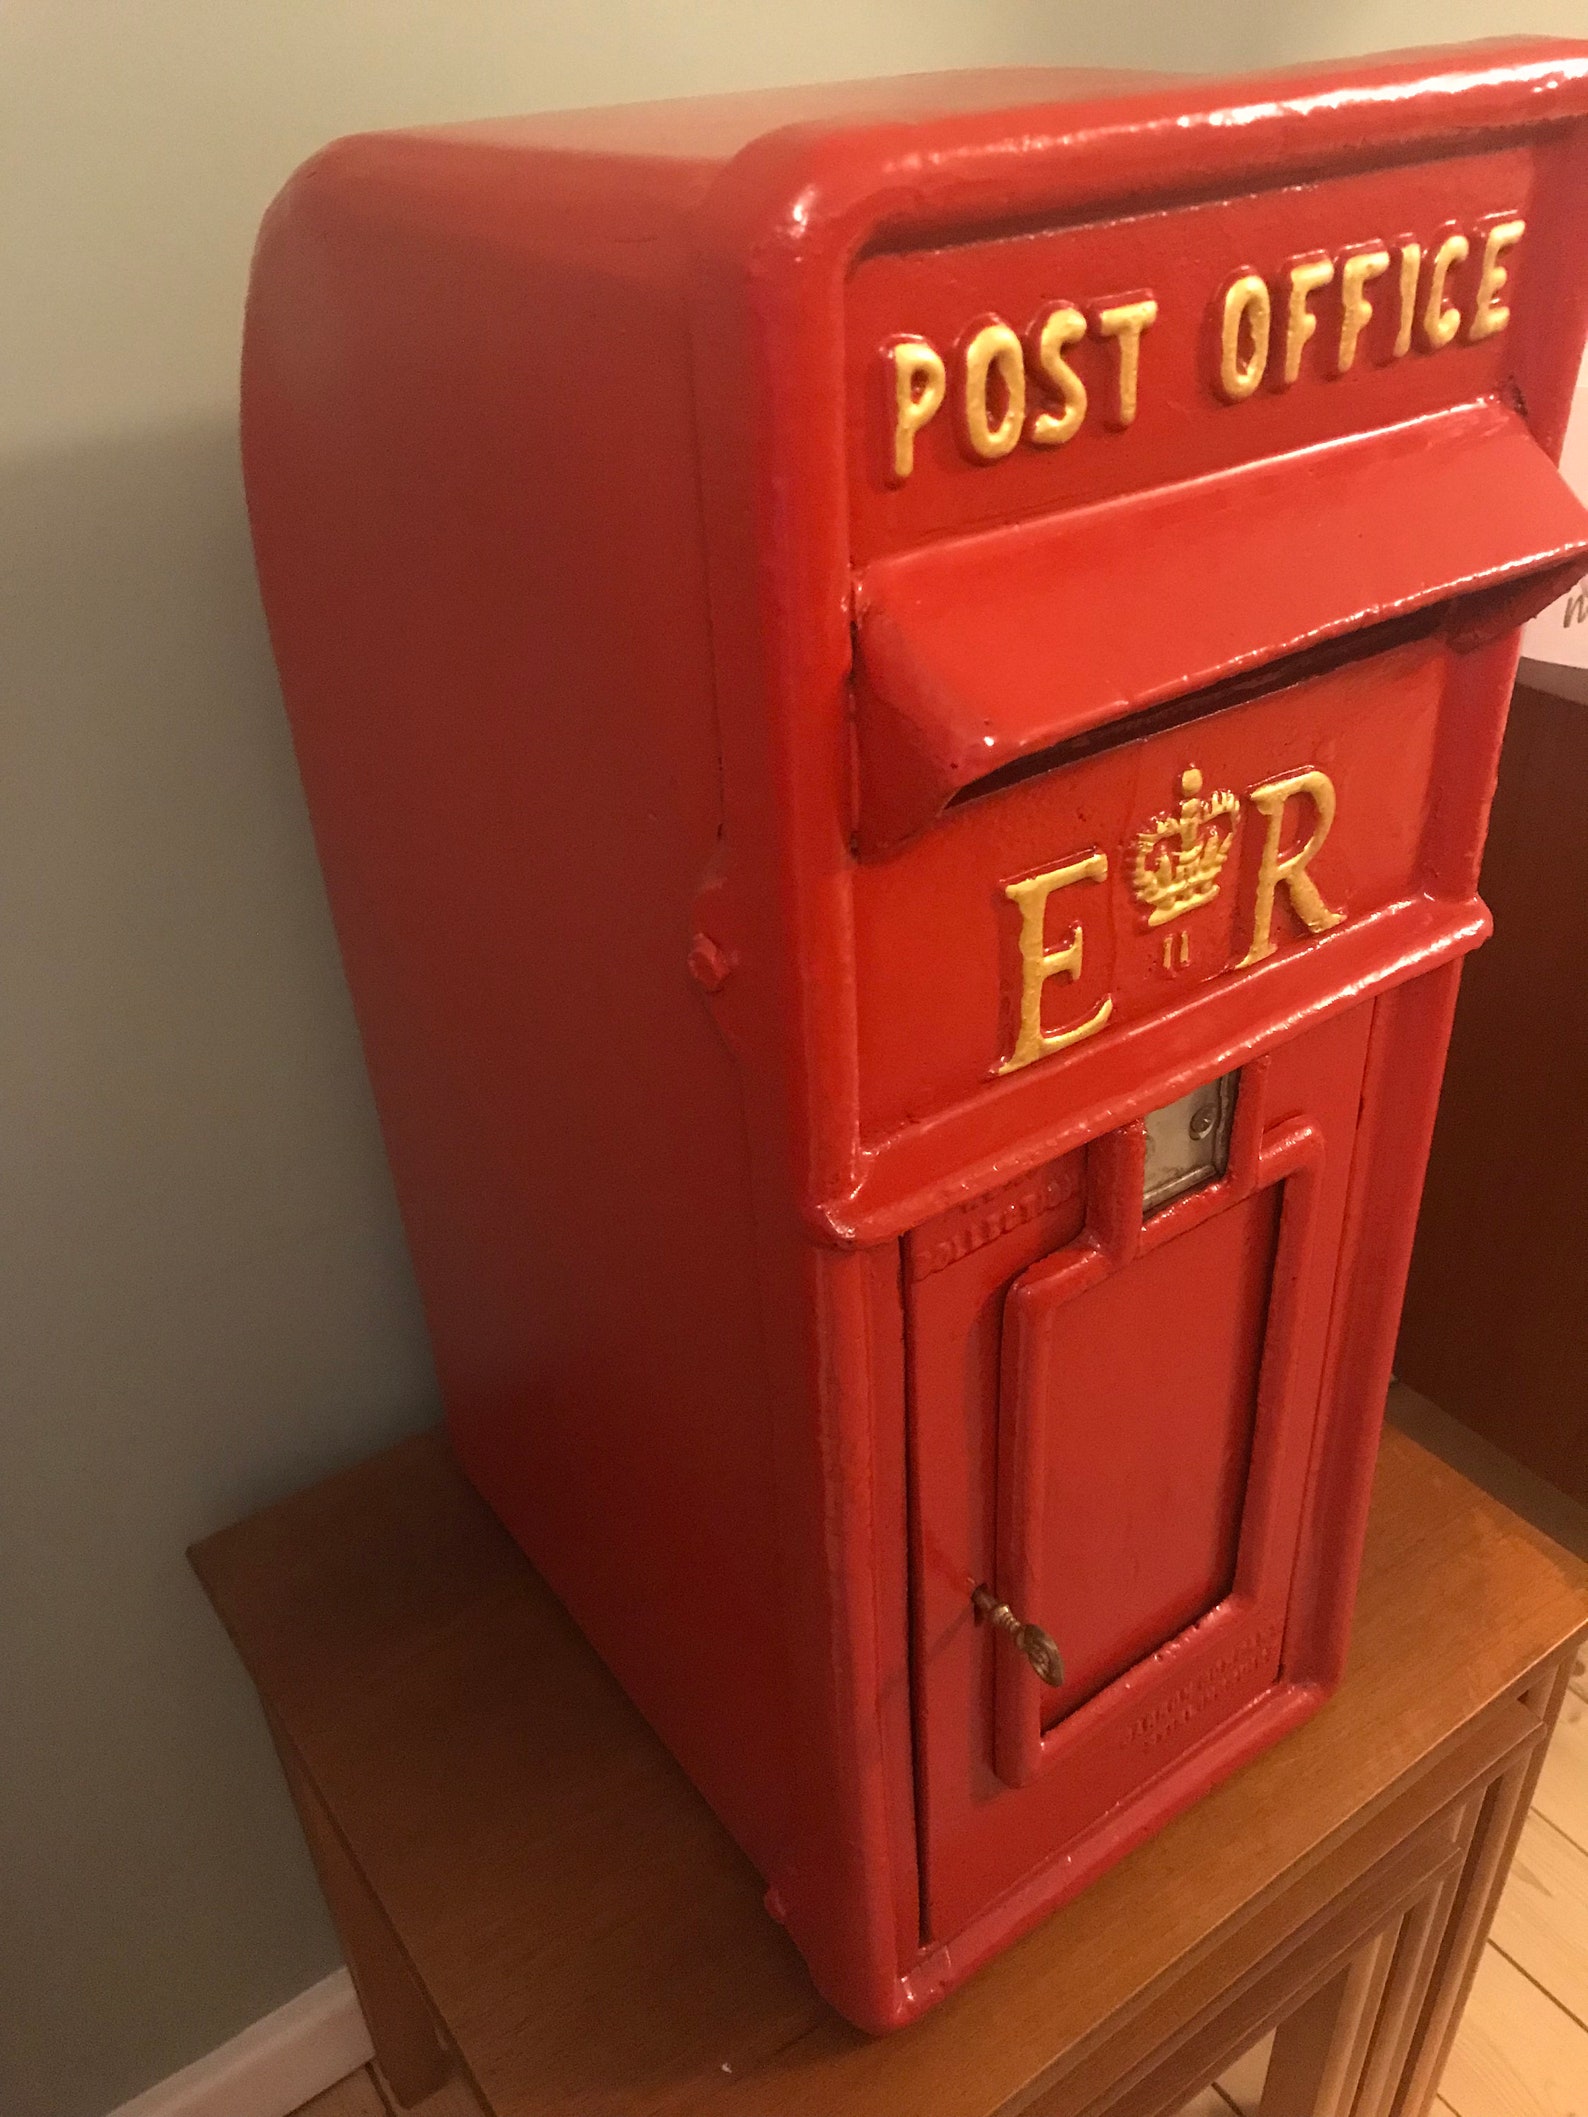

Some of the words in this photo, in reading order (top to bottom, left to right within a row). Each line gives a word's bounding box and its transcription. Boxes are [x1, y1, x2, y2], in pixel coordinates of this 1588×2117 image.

[888, 299, 1159, 478] POST
[1219, 216, 1527, 398] OFFICE
[997, 852, 1114, 1076] E
[1235, 769, 1348, 969] R
